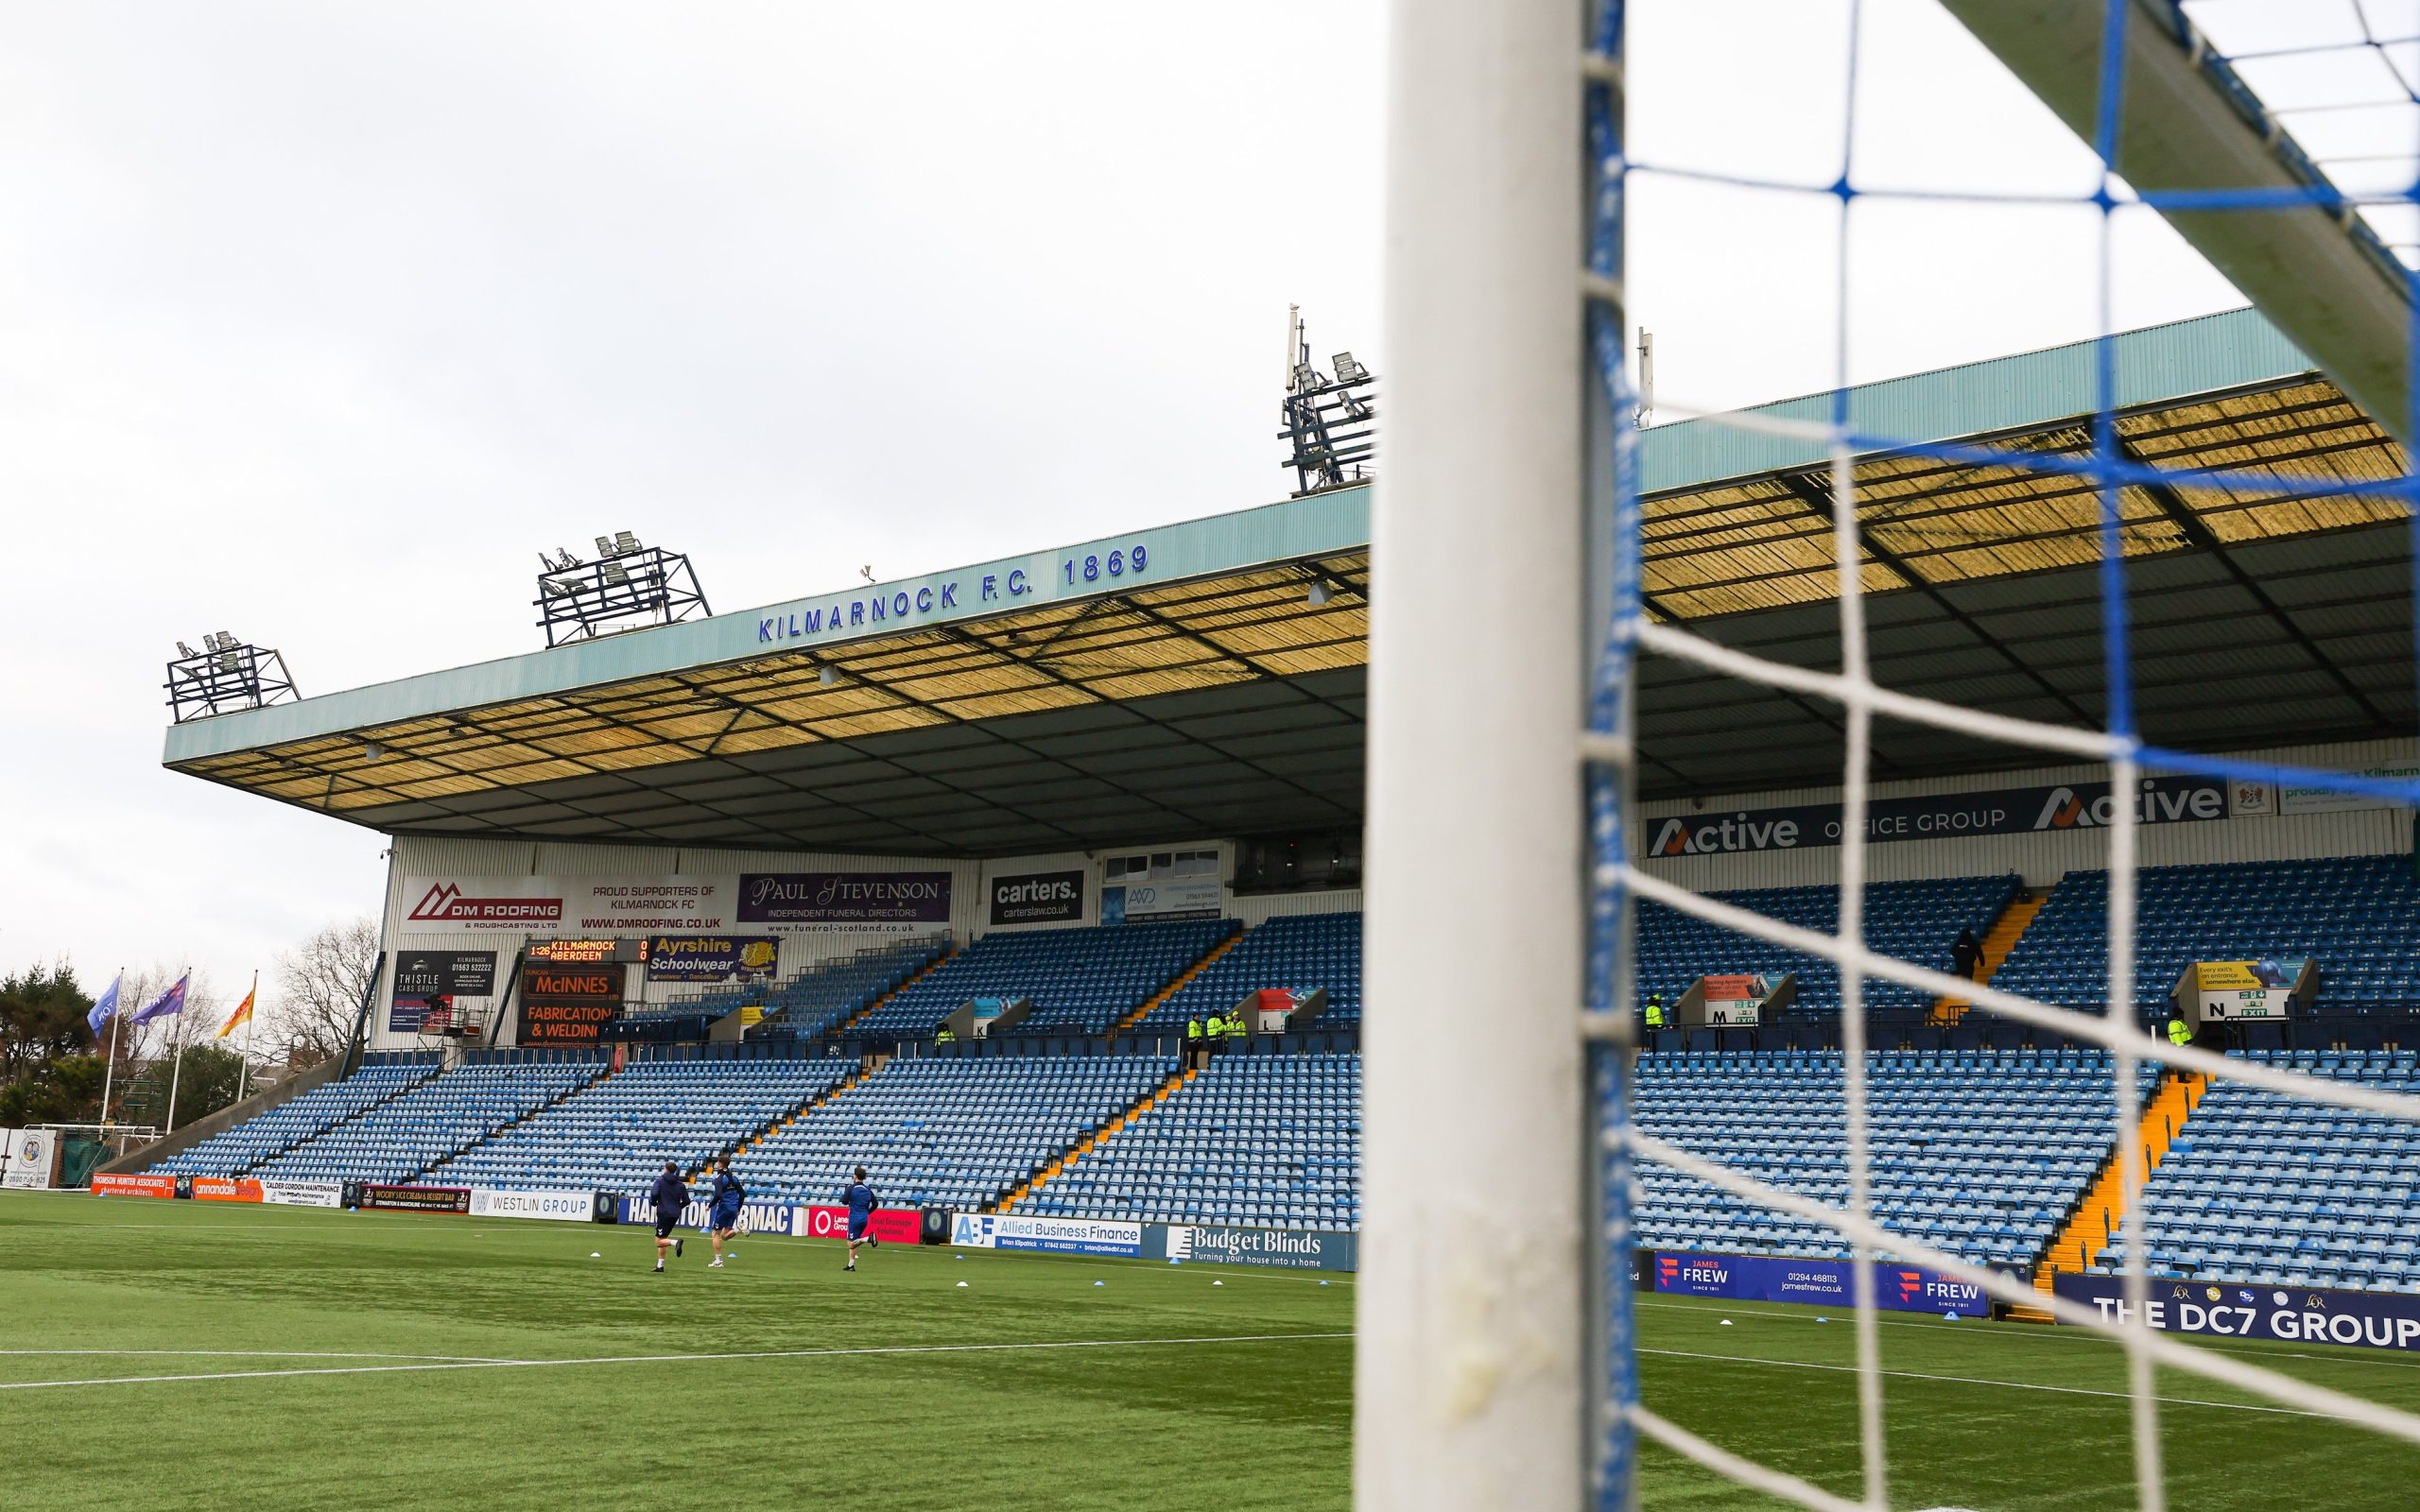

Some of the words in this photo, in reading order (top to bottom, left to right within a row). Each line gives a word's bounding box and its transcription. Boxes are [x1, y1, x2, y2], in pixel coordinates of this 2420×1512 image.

[759, 582, 958, 642] KILMARNOCK
[1064, 545, 1148, 583] 1869
[1650, 813, 1798, 855] Active
[1824, 816, 1908, 837] OICE
[1917, 809, 2006, 832] GROUP
[593, 886, 628, 896] PROUD
[631, 886, 698, 896] SUPPORTERS
[701, 886, 715, 896] OF
[750, 877, 808, 906] PAUL
[817, 876, 939, 905] STEVENSON
[996, 880, 1077, 904] carters.
[452, 905, 477, 916] DM
[484, 905, 559, 916] ROOFING
[611, 901, 677, 910] KILMARNOCK
[683, 901, 695, 909] FC
[1004, 905, 1069, 919] carterslaw.co.uk
[769, 909, 825, 918] INDEPENDENT
[827, 909, 865, 918] FUNERAL
[869, 908, 917, 918] DIRECTORS
[581, 919, 721, 929] WWW.DMROOFING.CO.UK
[768, 923, 914, 934] www.funeral-scotland.co.uk
[531, 947, 550, 955] 1:26
[551, 941, 615, 951] KILMARNOCK
[641, 940, 648, 951] 0
[655, 937, 732, 955] Ayrshire
[550, 951, 602, 960] ABERDEEN
[640, 951, 647, 960] 0
[649, 957, 734, 971] Schoolwear
[399, 974, 440, 985] THISTLE
[535, 976, 609, 993] McINNES
[528, 1006, 612, 1021] FABRICATION
[1713, 1011, 1726, 1022] M
[2209, 1003, 2224, 1017] N
[531, 1023, 542, 1037] &
[977, 1026, 983, 1037] K
[94, 1176, 116, 1184] THOMSON
[117, 1177, 136, 1185] HUNTER
[136, 1177, 164, 1187] ASSOCIATES
[101, 1187, 126, 1195] chartered
[127, 1188, 153, 1197] architects
[305, 1184, 339, 1193] MAINTENANCE
[493, 1196, 539, 1211] WESTLIN
[543, 1199, 587, 1214] GROUP
[629, 1197, 711, 1228] HATON
[834, 1215, 849, 1224] Lane
[1000, 1221, 1032, 1234] Allied
[1035, 1223, 1087, 1237] Business
[1090, 1226, 1138, 1241] Finance
[1195, 1228, 1261, 1255] Budget
[1264, 1231, 1322, 1254] Blinds
[1195, 1251, 1223, 1263] Turning
[1226, 1255, 1243, 1263] your
[1247, 1254, 1270, 1264] house
[1272, 1255, 1288, 1265] into
[1299, 1257, 1321, 1267] home
[1693, 1260, 1719, 1268] JAMES
[1684, 1268, 1728, 1283] FREW
[1789, 1273, 1810, 1281] 01294
[1812, 1274, 1838, 1283] 468113
[1782, 1281, 1842, 1293] jamesfrew.co.uk
[1927, 1282, 1979, 1299] FREW
[2093, 1297, 2166, 1328] THE
[2180, 1304, 2256, 1334] DC7
[2270, 1310, 2420, 1348] GROUP
